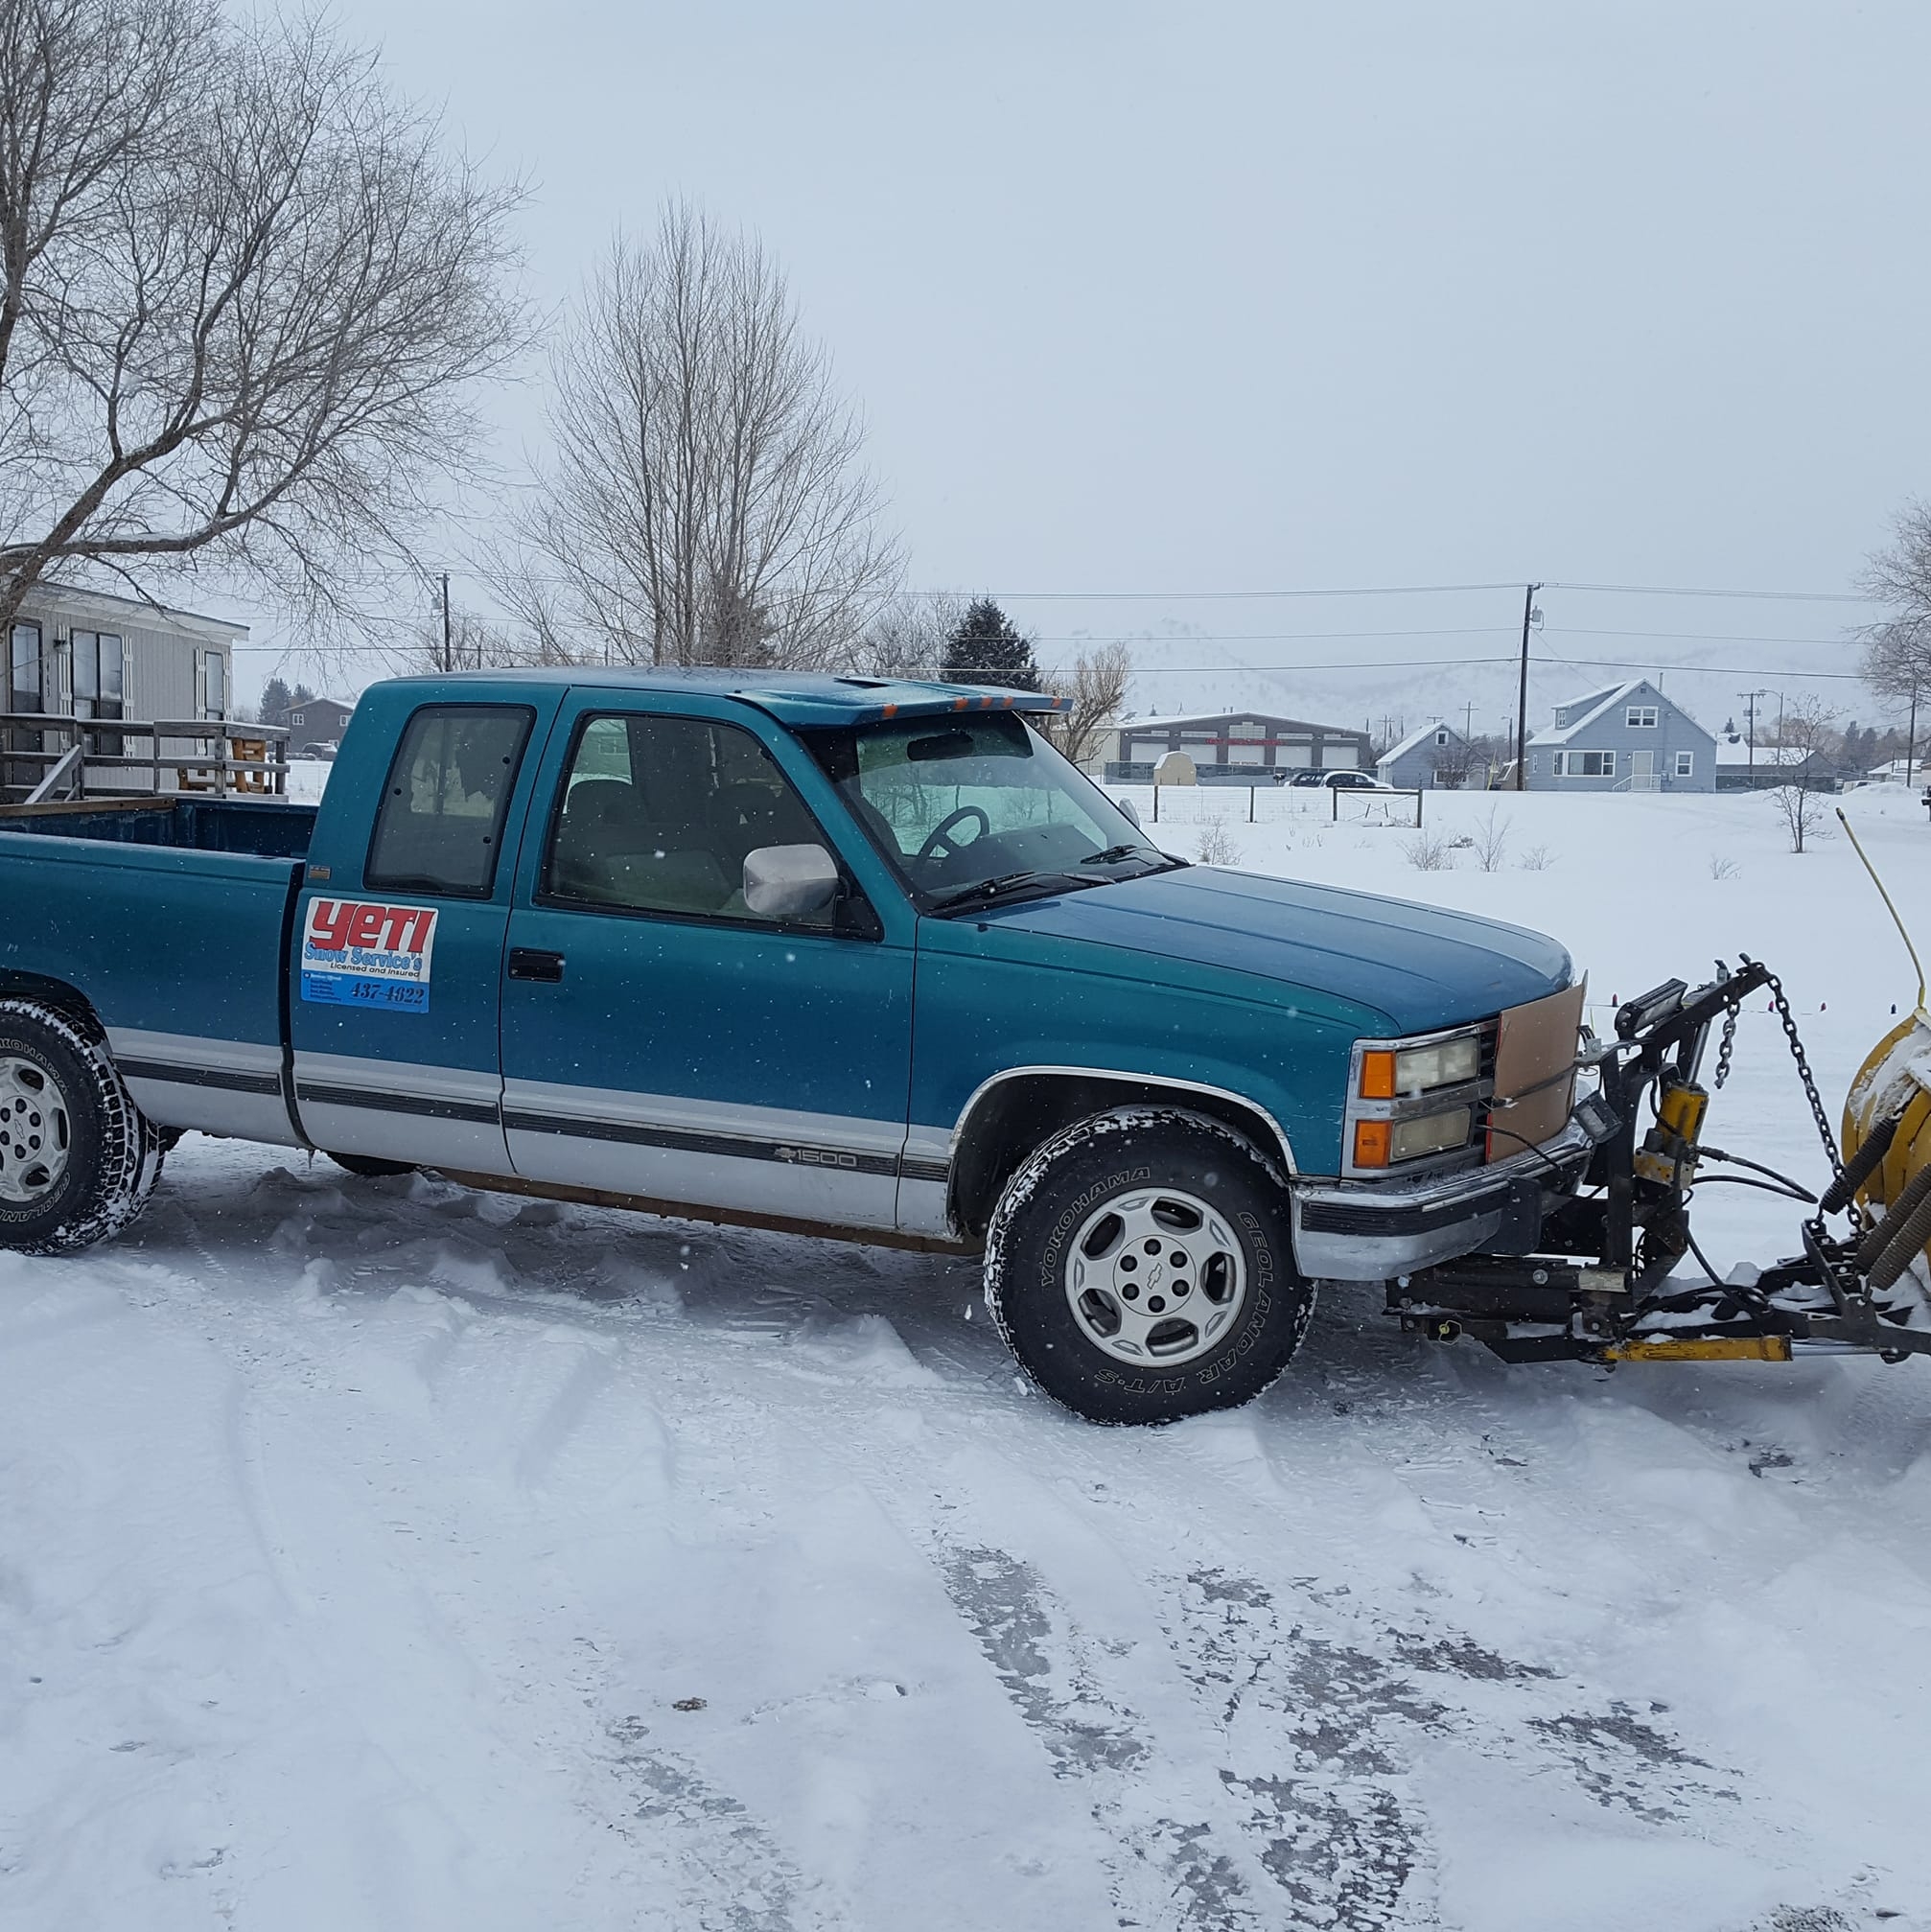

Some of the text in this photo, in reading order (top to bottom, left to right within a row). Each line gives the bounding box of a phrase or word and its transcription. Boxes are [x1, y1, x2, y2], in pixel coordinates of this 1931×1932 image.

[304, 942, 423, 971] Snow Service's
[330, 962, 421, 978] Licensed and Insured
[798, 1150, 856, 1166] 1500
[1041, 1167, 1151, 1287] YOKOHAMA
[1198, 1212, 1274, 1384] GEOLANDAR
